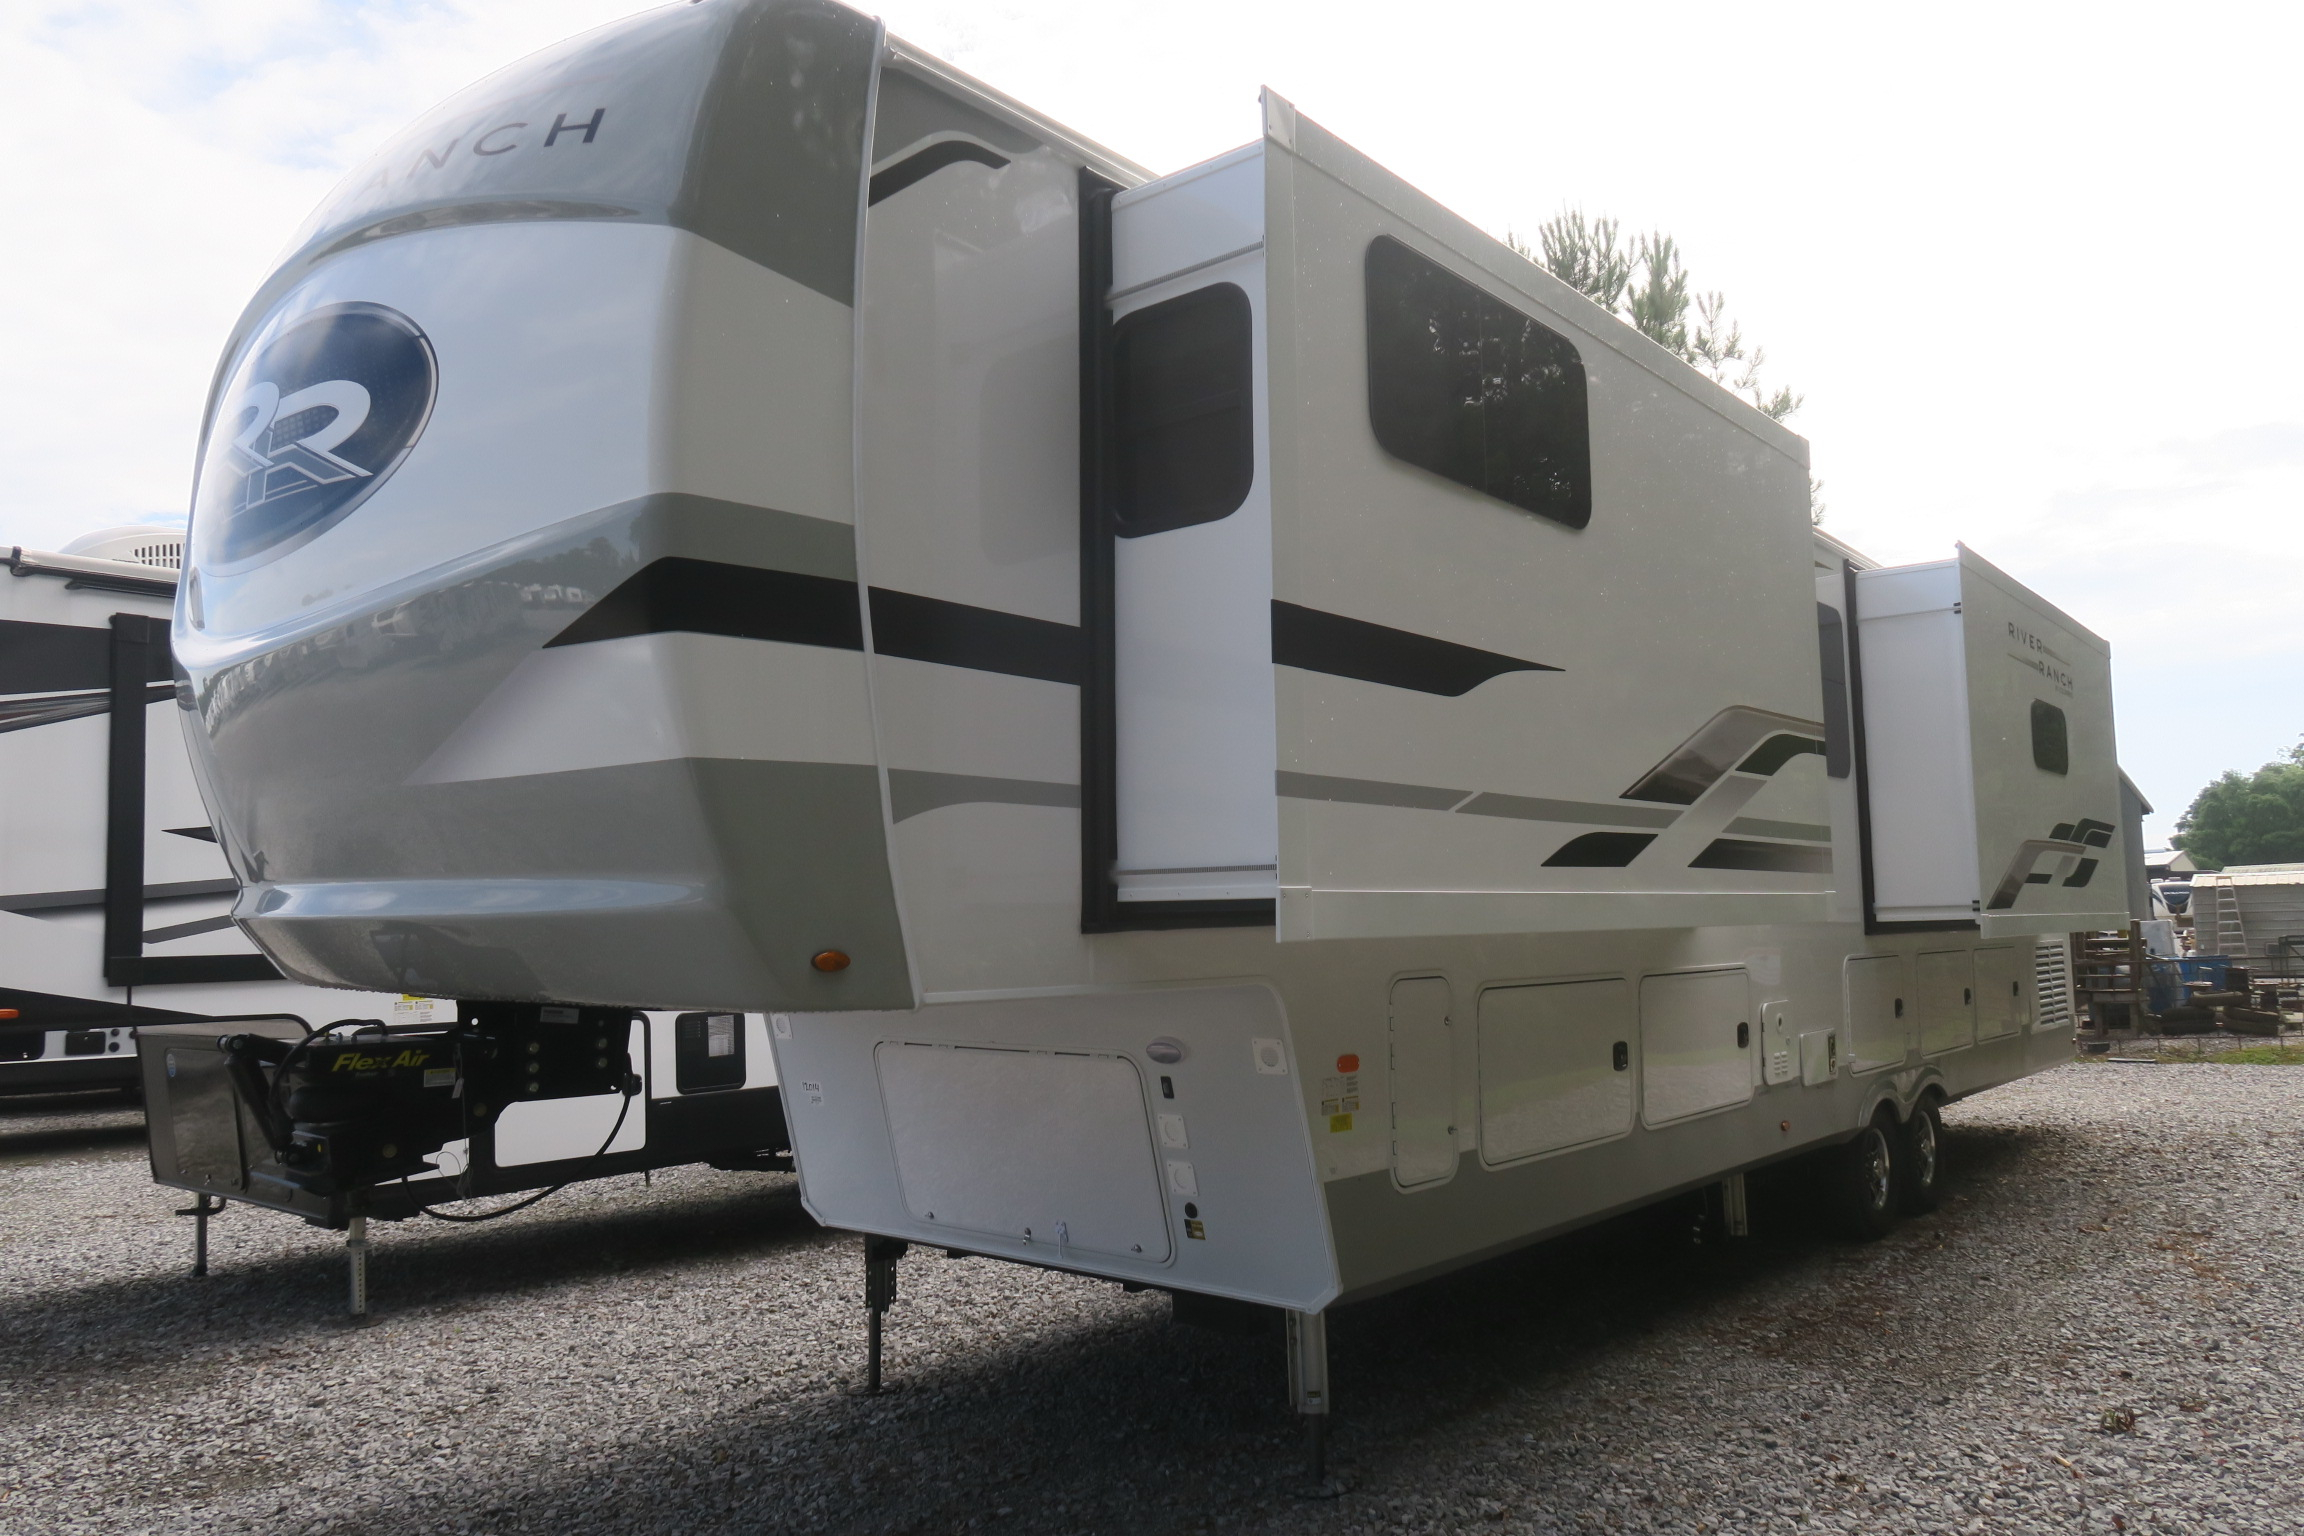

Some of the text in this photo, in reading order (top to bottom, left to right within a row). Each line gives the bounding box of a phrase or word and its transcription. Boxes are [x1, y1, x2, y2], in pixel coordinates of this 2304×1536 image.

[353, 107, 606, 200] ANCH
[2007, 621, 2043, 654] RIVER
[2038, 660, 2074, 691] RANCH
[331, 1049, 431, 1072] Flex Air
